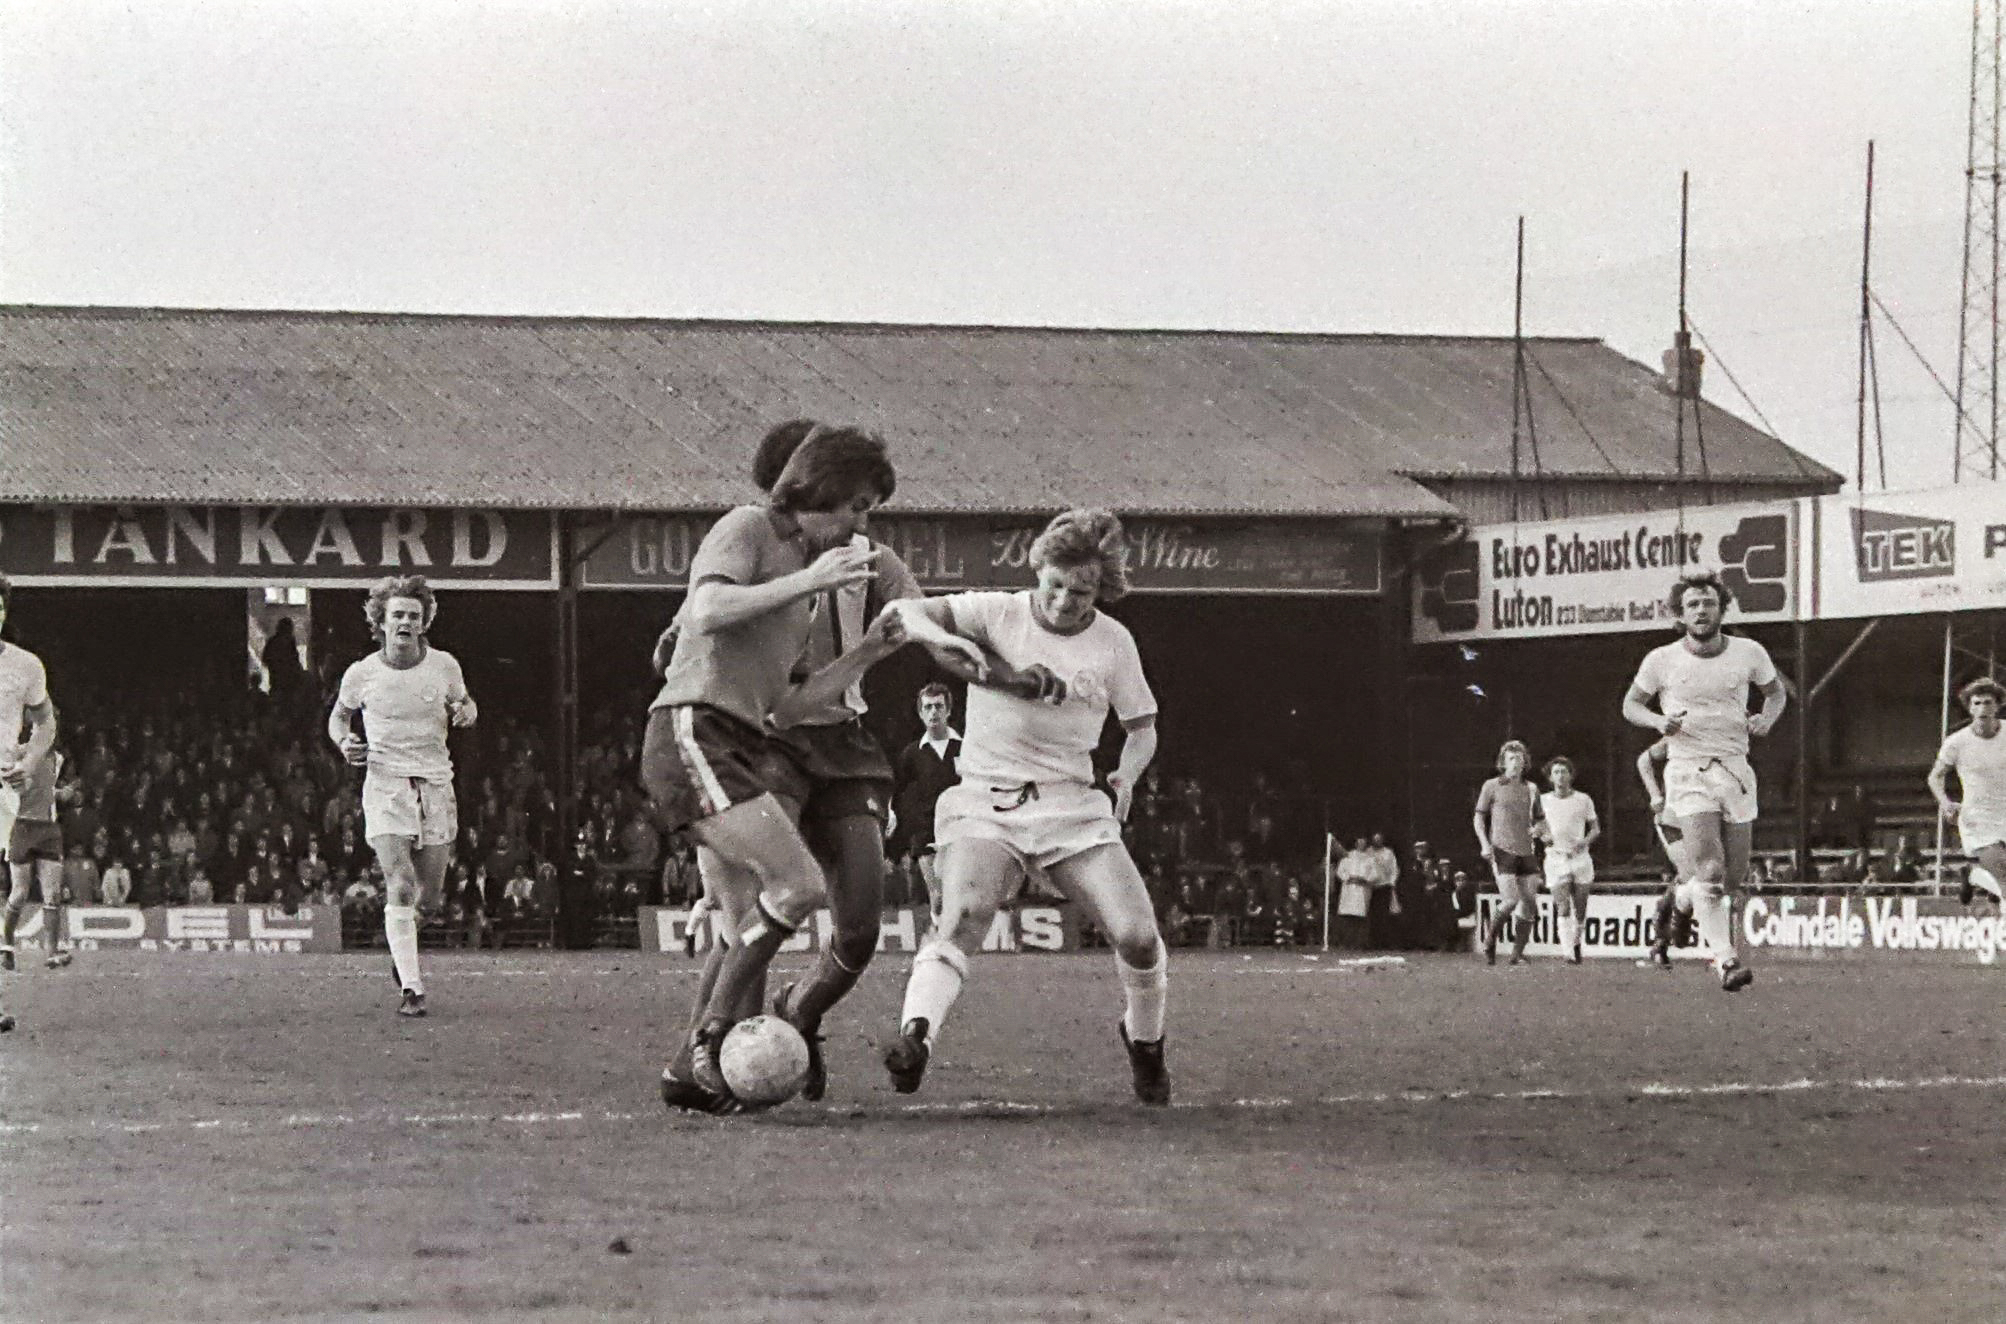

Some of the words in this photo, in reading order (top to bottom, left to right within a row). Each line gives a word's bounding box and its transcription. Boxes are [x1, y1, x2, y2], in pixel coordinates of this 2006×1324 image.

[46, 506, 508, 567] TANKARD
[1493, 538, 1540, 579] Euro
[1545, 532, 1631, 576] Exhaust
[1635, 526, 1703, 569] Centre
[1863, 526, 1952, 573] TEK
[1493, 589, 1553, 630] Luton
[1743, 897, 1864, 948] Colindale
